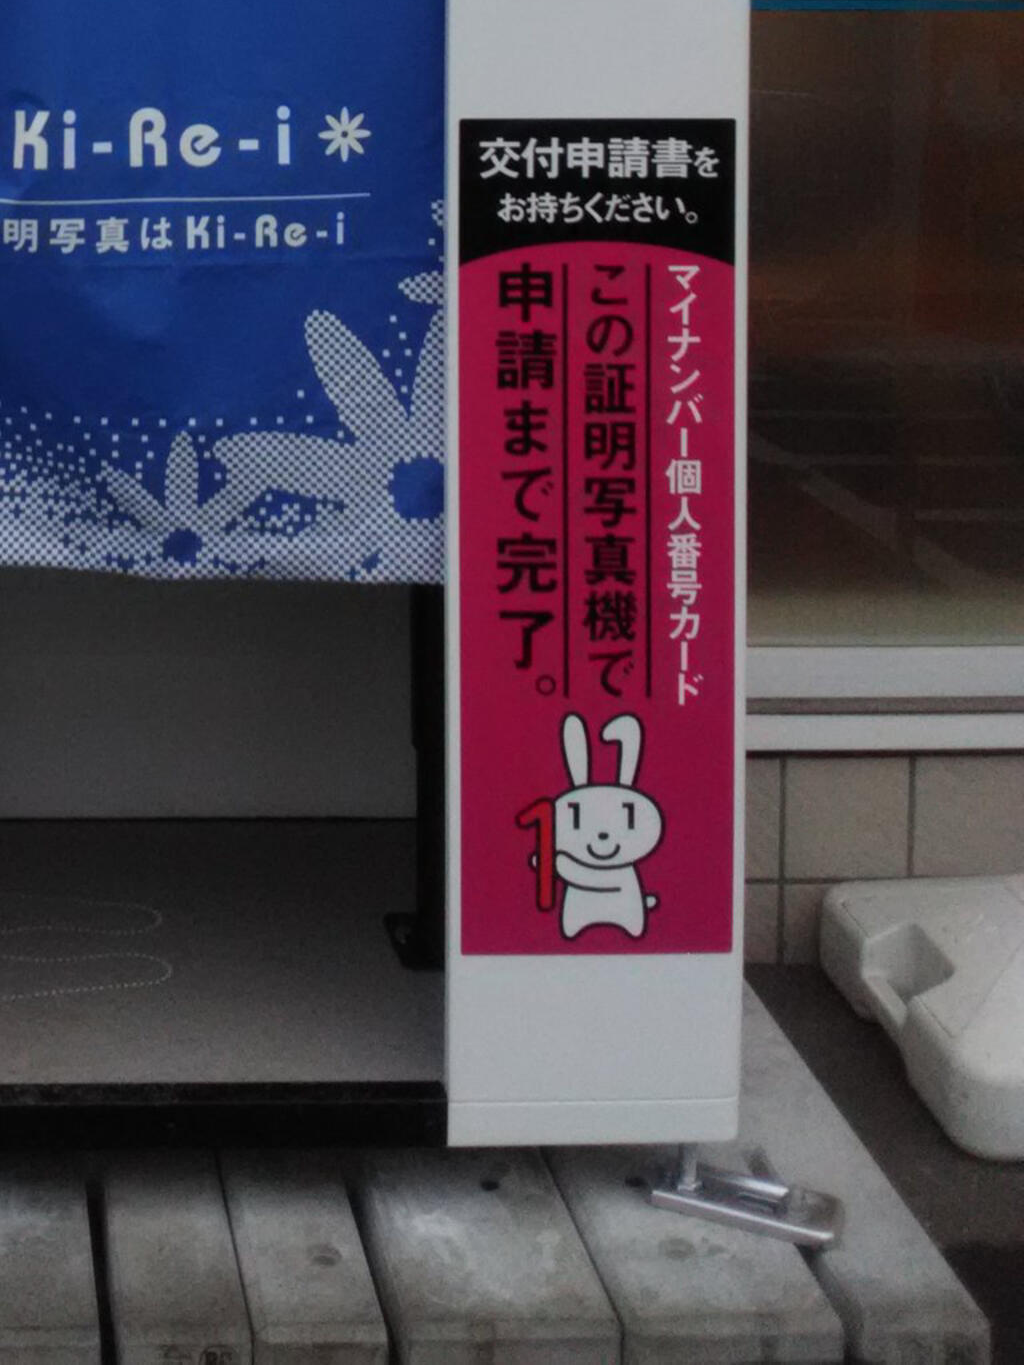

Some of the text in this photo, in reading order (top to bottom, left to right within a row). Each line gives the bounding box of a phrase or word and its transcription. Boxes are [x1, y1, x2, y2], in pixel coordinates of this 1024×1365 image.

[12, 105, 292, 172] Ki-Re-i
[478, 136, 721, 180] 交付申請書を
[497, 191, 700, 225] お持ちください。
[495, 262, 559, 698] 申請まで完了。
[582, 263, 638, 699] この証明写真機で
[666, 264, 704, 706] マイナンバー個人番号カード
